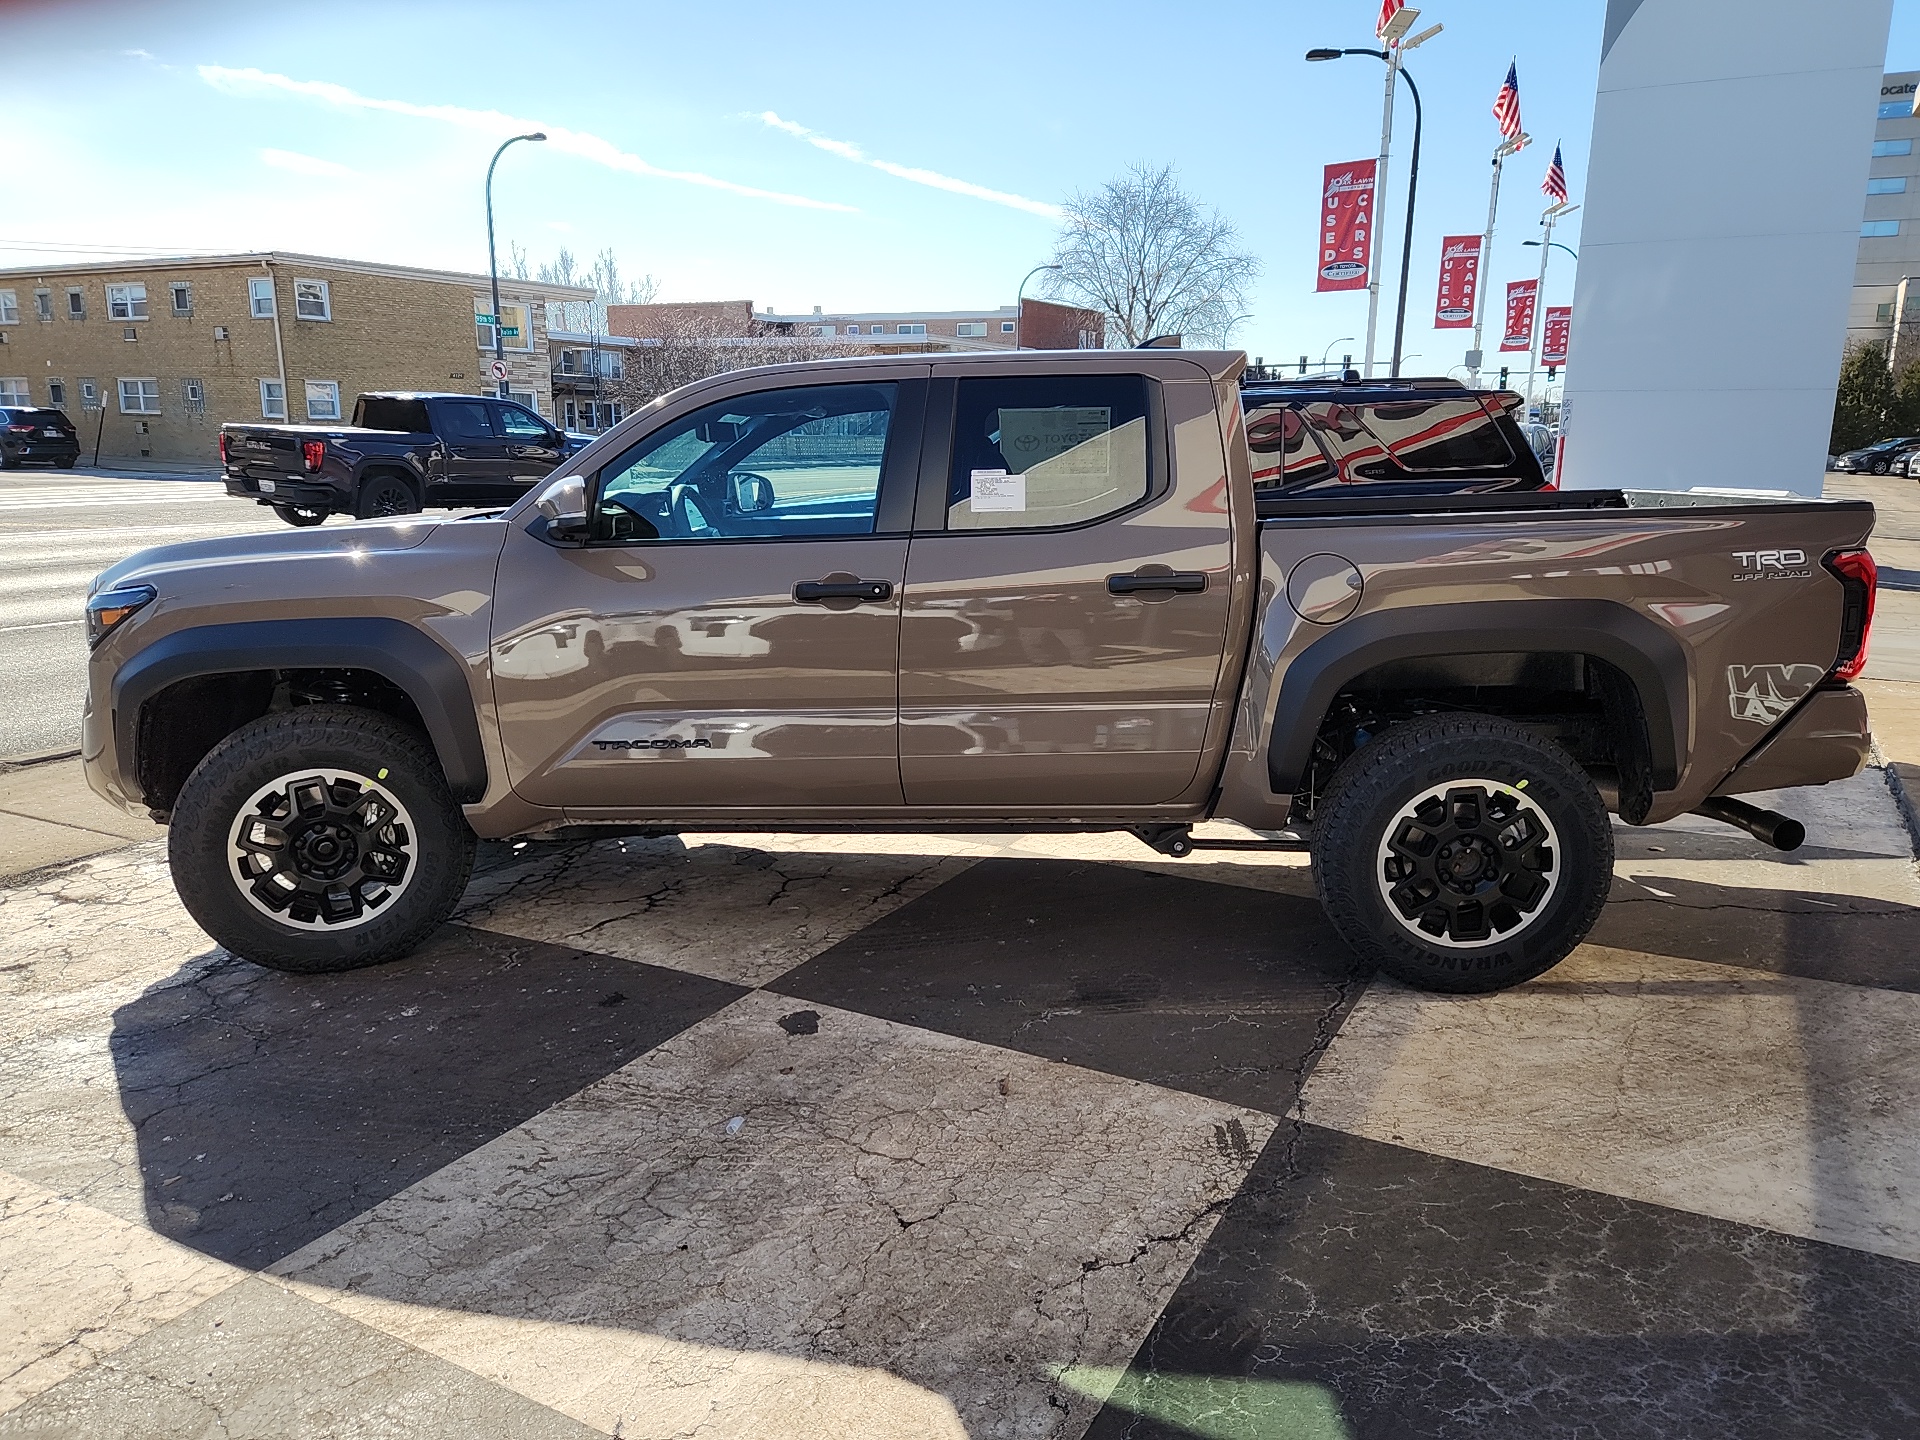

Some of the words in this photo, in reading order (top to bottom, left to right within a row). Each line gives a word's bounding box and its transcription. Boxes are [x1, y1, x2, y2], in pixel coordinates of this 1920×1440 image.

[1324, 196, 1339, 262] USED
[1353, 194, 1369, 259] CARS
[1440, 260, 1453, 307] USED
[1461, 259, 1475, 306] CARS
[1521, 297, 1533, 335] CARS
[1544, 321, 1553, 353] USED
[1559, 321, 1568, 352] CARS
[1731, 549, 1806, 571] TRD
[1732, 572, 1764, 582] OFF
[1766, 569, 1812, 580] ROAD
[591, 738, 712, 750] TACOMA
